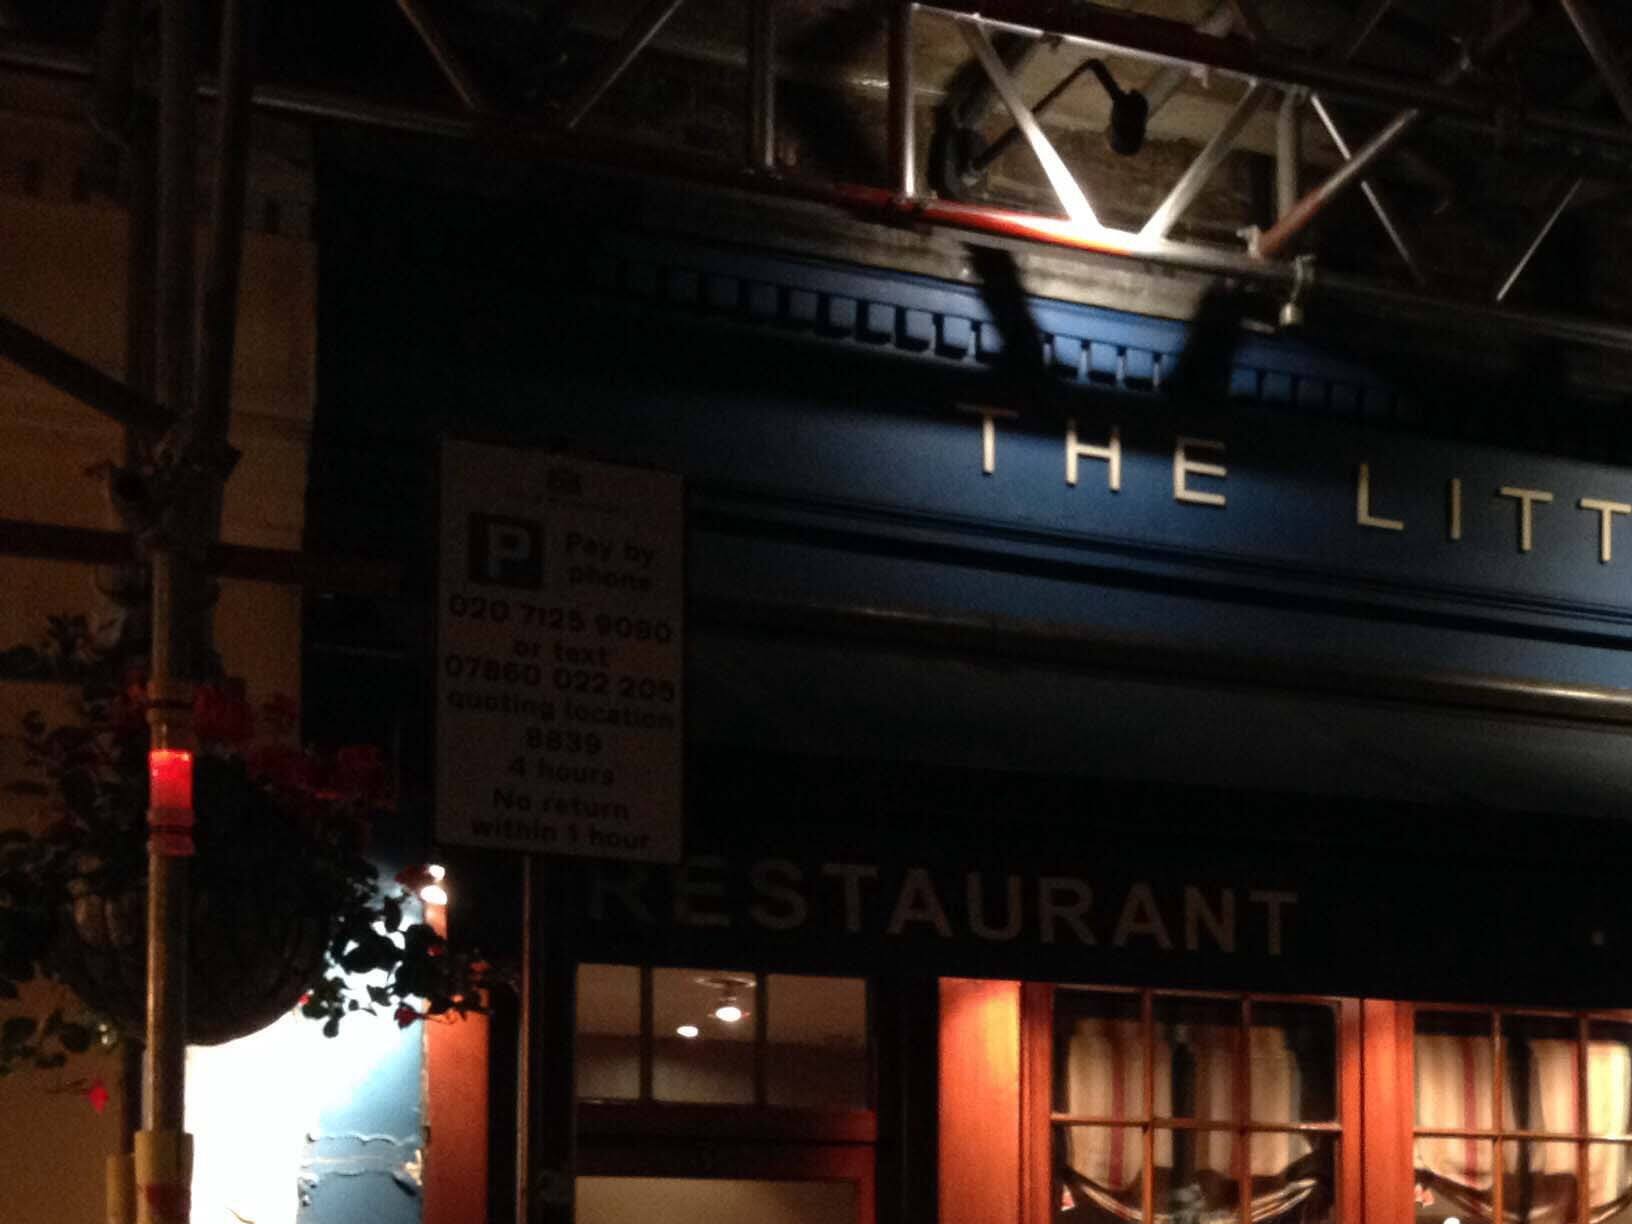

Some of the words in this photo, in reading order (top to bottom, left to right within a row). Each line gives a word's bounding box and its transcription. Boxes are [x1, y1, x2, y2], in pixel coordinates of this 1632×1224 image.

[957, 402, 1228, 509] THE
[487, 523, 531, 579] P
[565, 531, 612, 563] Pay
[623, 540, 655, 569] by
[568, 566, 652, 592] phone
[448, 593, 511, 623] 020
[513, 640, 542, 658] or
[554, 642, 610, 668] text
[552, 667, 610, 695] 022
[446, 690, 556, 721] quoting
[563, 700, 674, 730] location
[508, 756, 527, 778] 4
[537, 757, 615, 787] hours
[493, 787, 532, 811] No
[542, 797, 630, 821] return
[471, 817, 558, 842] within
[589, 824, 653, 850] hour
[587, 855, 1301, 957] RESTAURANT
